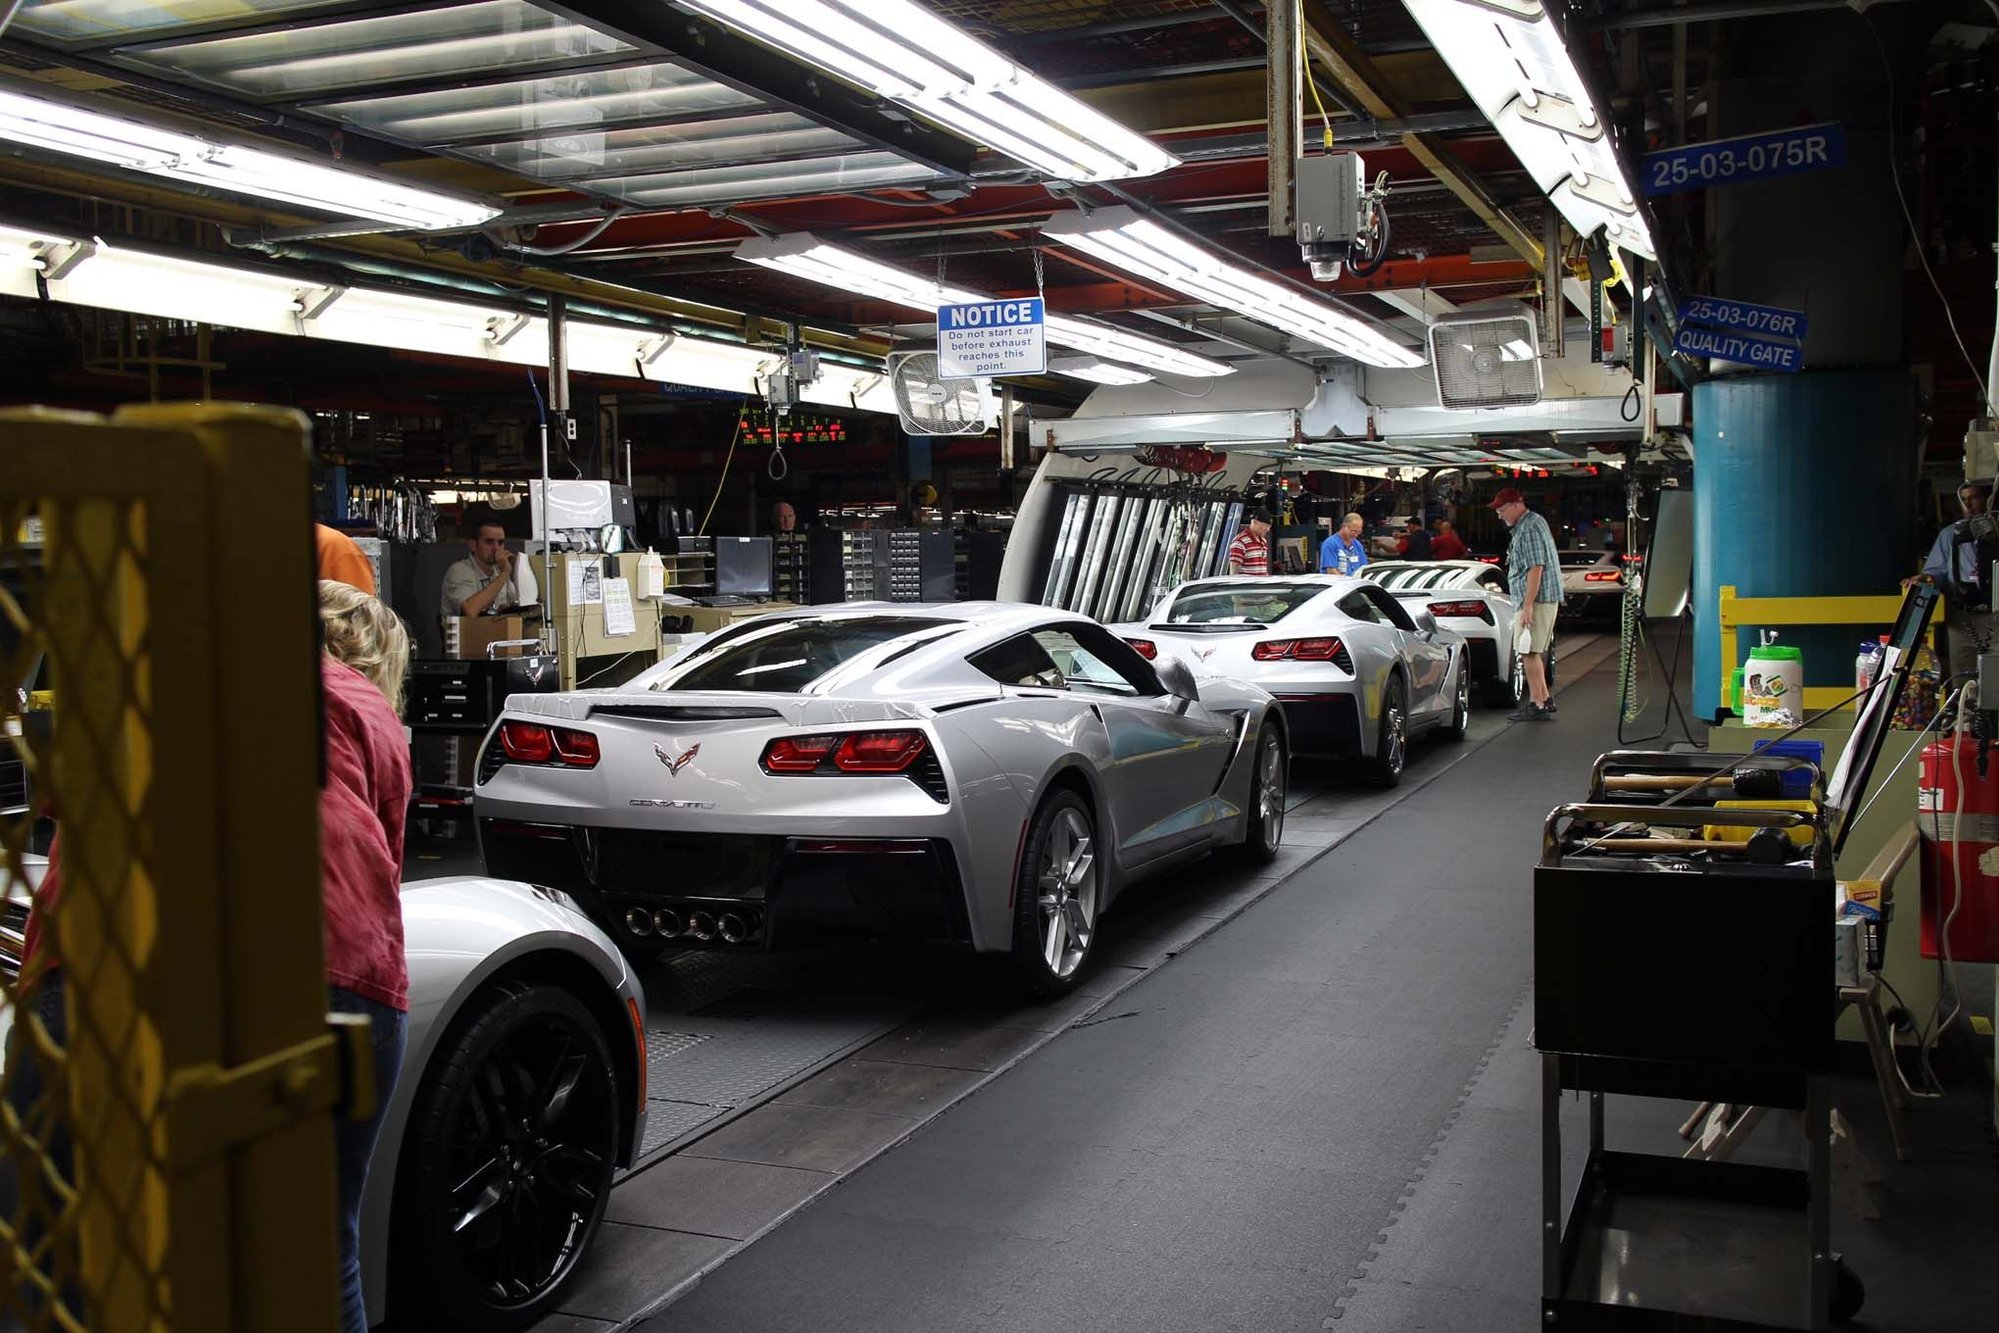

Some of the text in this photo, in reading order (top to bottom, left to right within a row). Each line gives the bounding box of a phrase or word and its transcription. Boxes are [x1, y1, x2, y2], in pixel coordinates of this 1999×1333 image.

[1653, 135, 1828, 187] 25-03-075R
[951, 303, 1031, 326] NOTICE
[1688, 301, 1797, 334] 25-03-076R
[949, 327, 1034, 340] Do not start car
[951, 338, 1031, 351] before exhaust
[1680, 330, 1795, 367] QUALITY GATE
[958, 350, 1025, 361] reaches this
[976, 362, 1006, 372] point.
